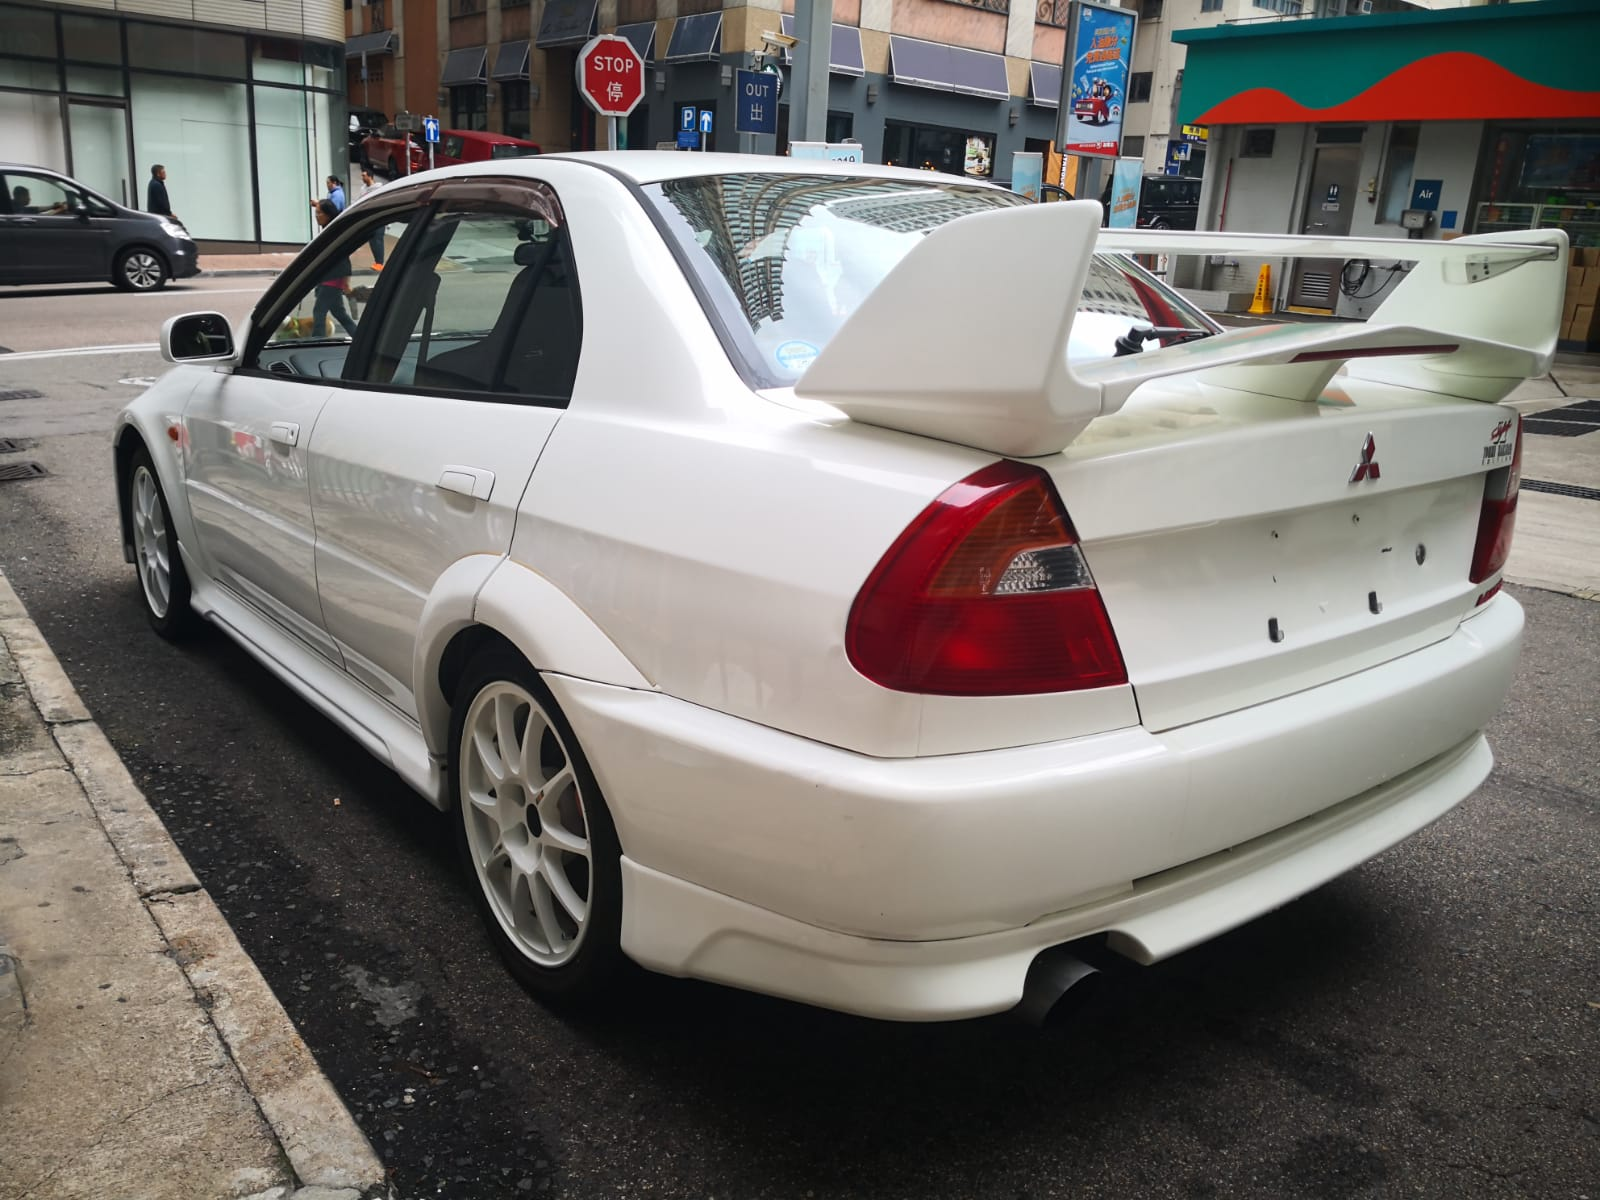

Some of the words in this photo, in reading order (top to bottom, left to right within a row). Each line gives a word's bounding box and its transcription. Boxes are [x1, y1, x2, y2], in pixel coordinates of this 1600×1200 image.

[594, 55, 634, 73] STOP
[606, 81, 624, 102] 停
[745, 83, 769, 97] OUT
[684, 109, 693, 128] P
[751, 103, 763, 121] 出
[1419, 190, 1433, 199] Air
